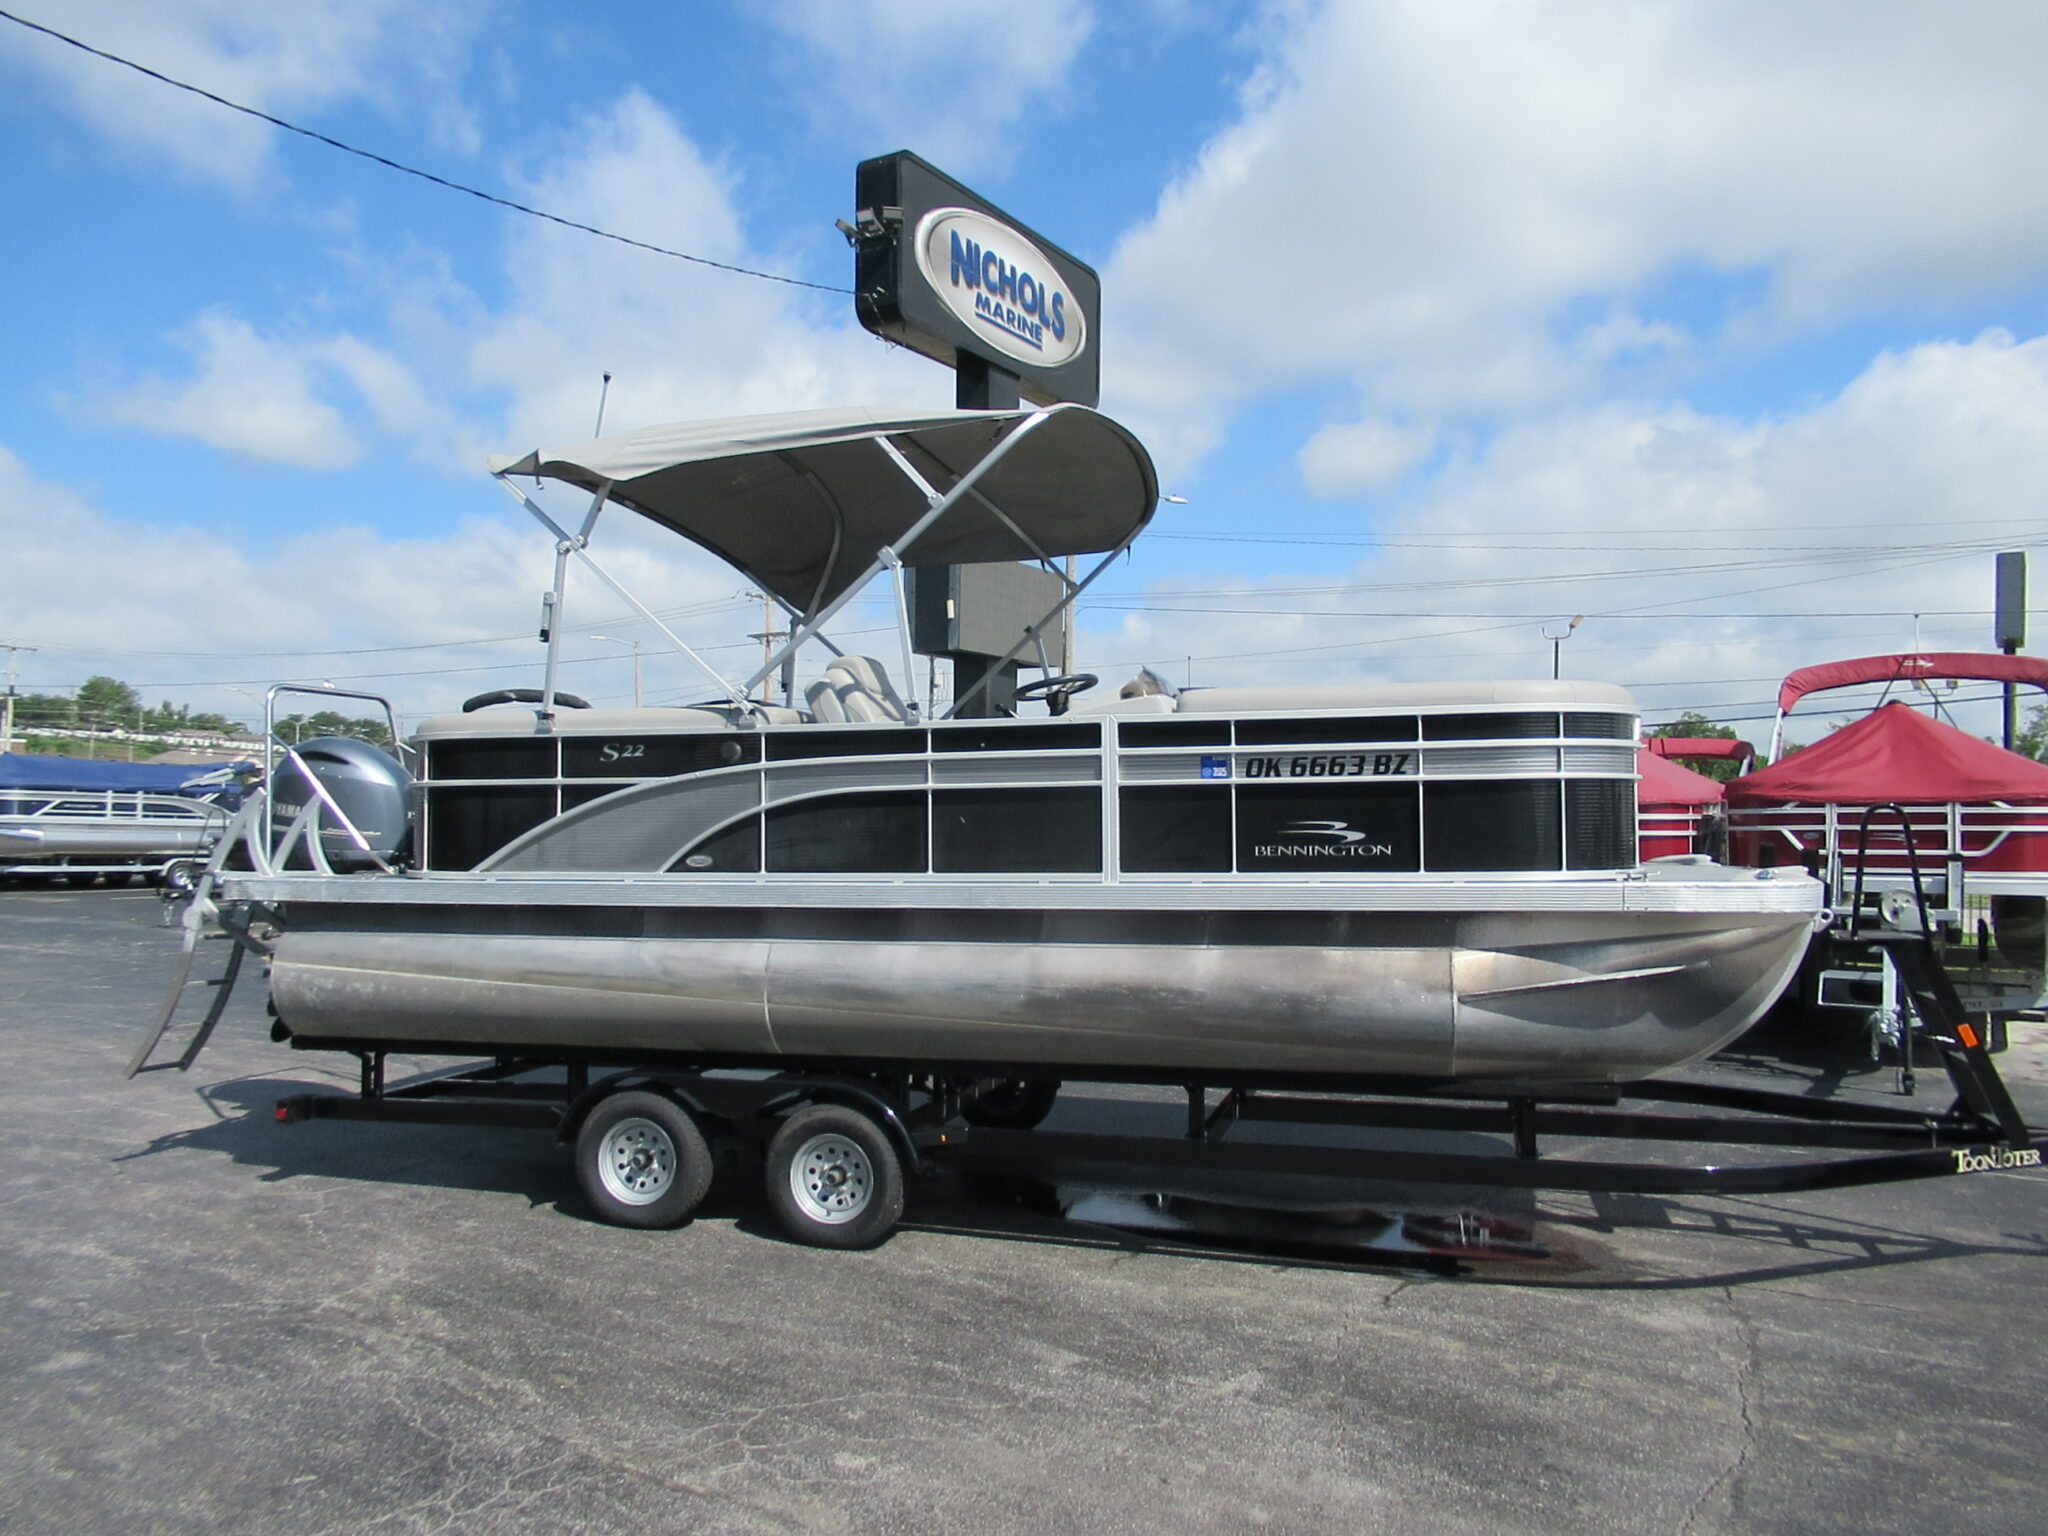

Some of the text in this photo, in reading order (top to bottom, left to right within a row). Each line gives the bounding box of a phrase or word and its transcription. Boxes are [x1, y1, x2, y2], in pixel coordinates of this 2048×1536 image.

[950, 228, 1065, 342] NICHOLS
[974, 291, 1043, 343] MARINE
[600, 743, 645, 762] S22
[1245, 753, 1410, 778] OK 6663 BZ
[1254, 844, 1393, 857] BENNINGTON
